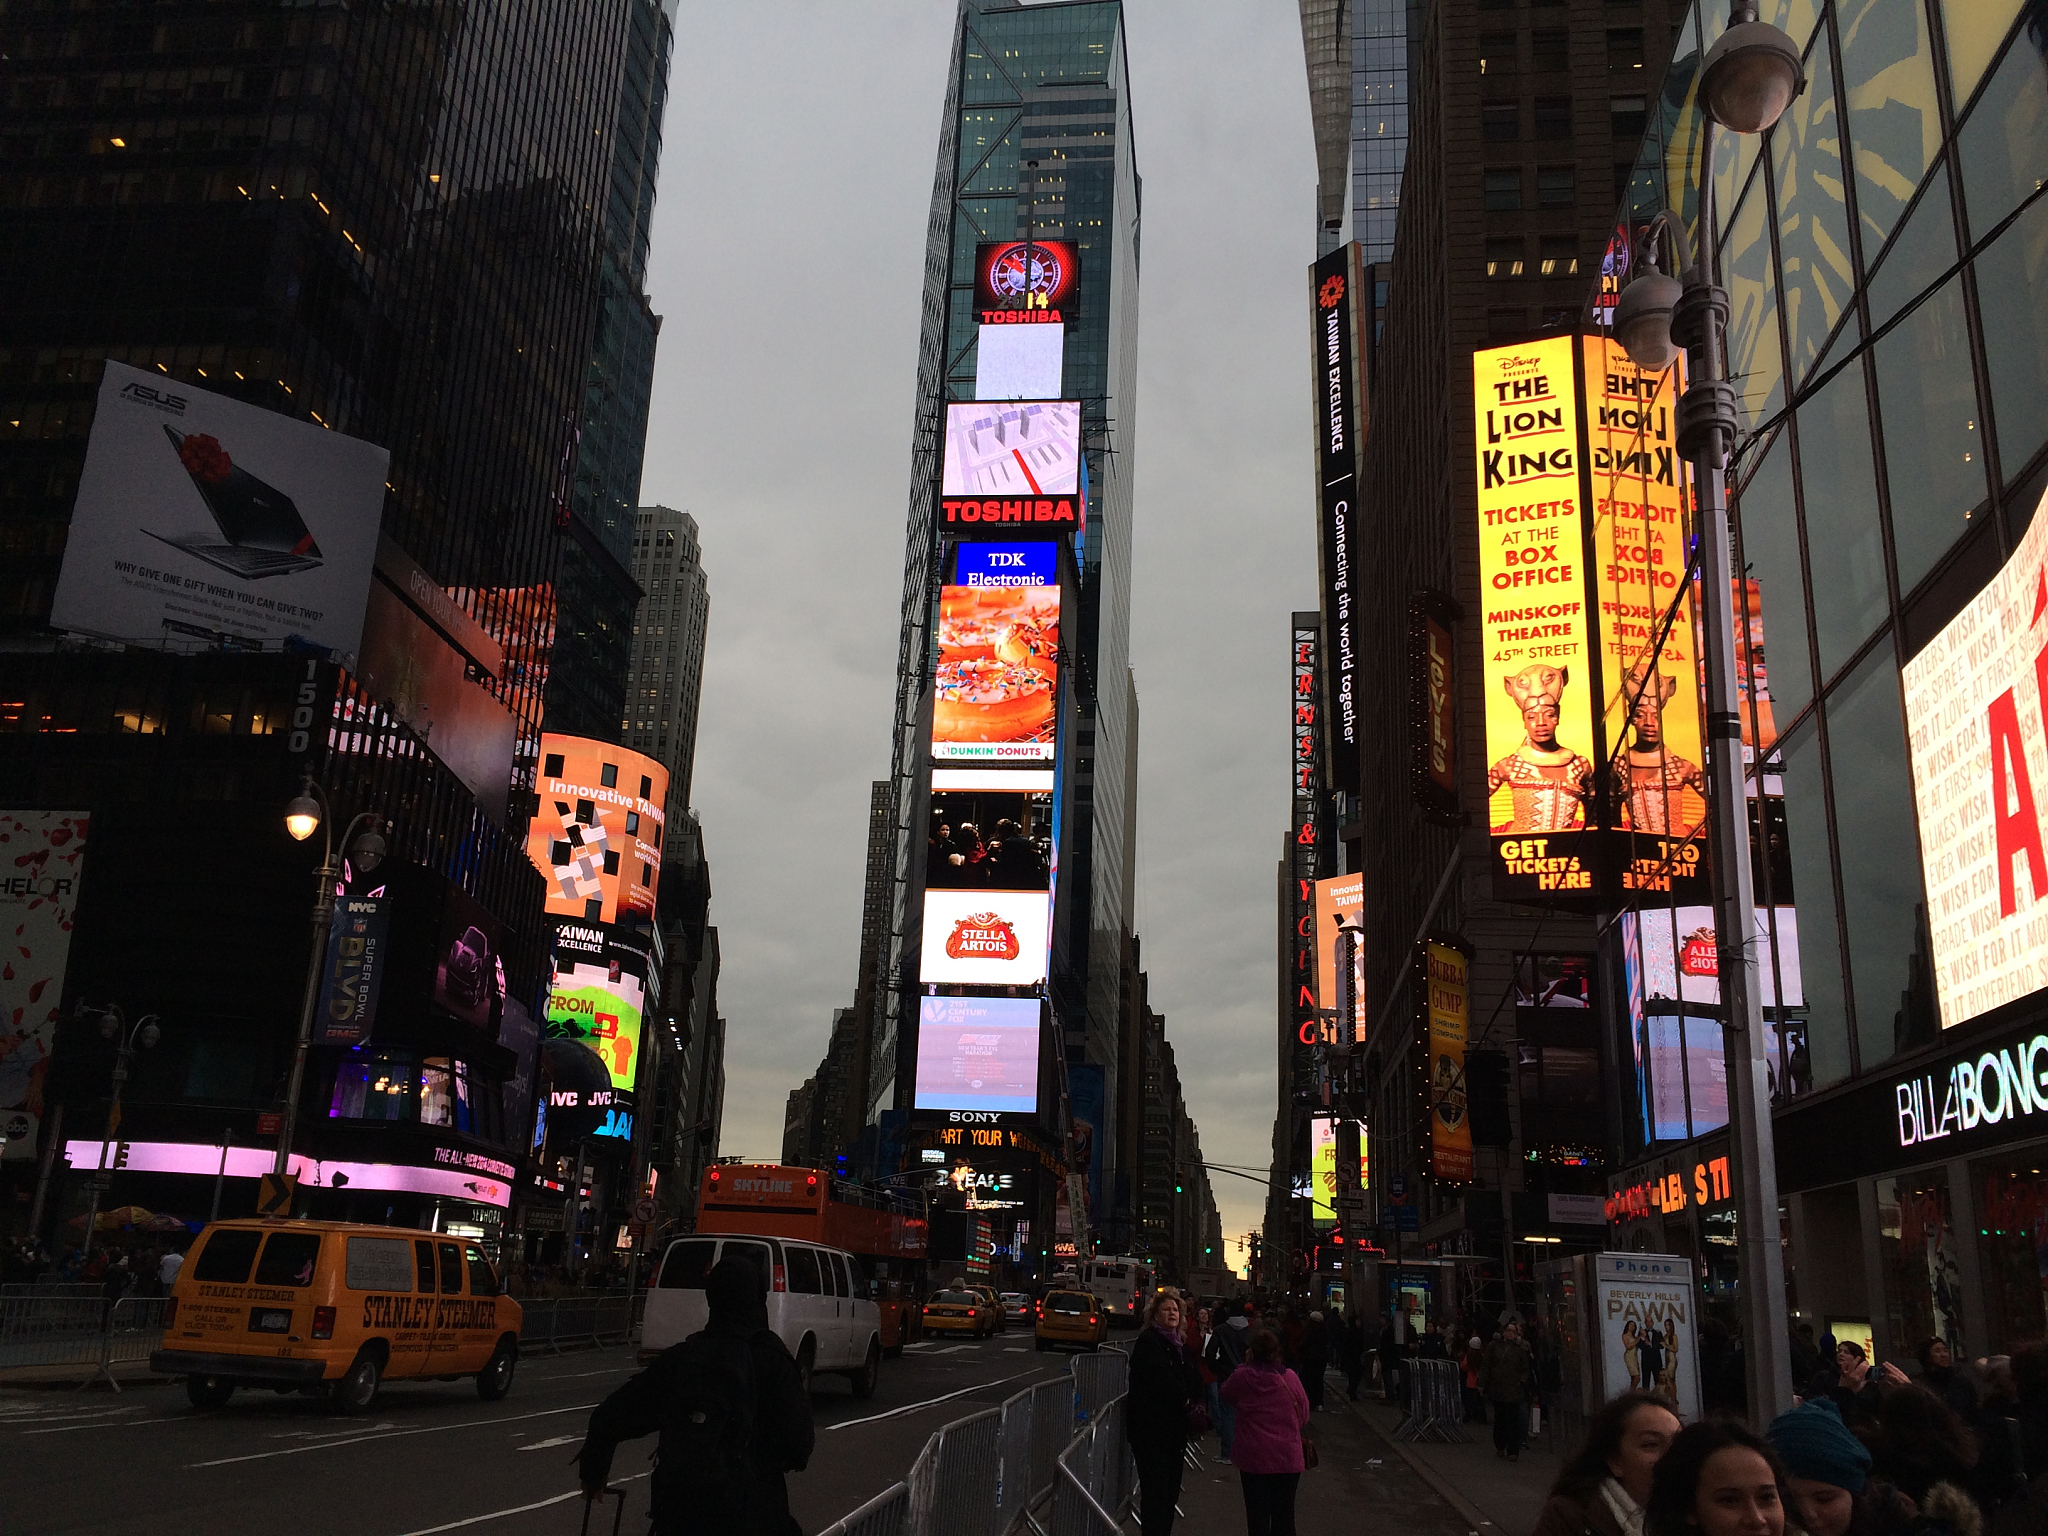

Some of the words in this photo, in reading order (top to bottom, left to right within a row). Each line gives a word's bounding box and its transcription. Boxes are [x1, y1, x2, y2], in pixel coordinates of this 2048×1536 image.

[996, 291, 1049, 310] 2014
[981, 310, 1062, 324] TOSHIBA
[1327, 308, 1339, 366] TAIWAN
[1503, 367, 1539, 377] PRESENTS
[121, 382, 187, 410] ASUS
[1493, 374, 1549, 402] THE
[1329, 366, 1343, 454] EXCELLENCE
[1486, 407, 1562, 444] LION
[1483, 447, 1573, 490] KING
[942, 501, 1074, 522] TOSHIBA
[1484, 499, 1575, 526] TICKETS
[1335, 500, 1348, 591] Connecting
[1501, 530, 1521, 546] AT
[1526, 526, 1559, 542] THE
[988, 553, 1026, 567] TDK
[1505, 545, 1558, 567] BOX
[967, 572, 1045, 586] Electronic
[1492, 565, 1572, 590] OFFICE
[115, 560, 137, 574] WHY
[138, 566, 161, 580] GIVE
[163, 572, 182, 586] ONE
[184, 578, 206, 592] GIFT
[207, 583, 234, 599] WHEN
[237, 591, 255, 605] YOU
[256, 596, 275, 610] CAN
[277, 602, 297, 616] GIVE
[300, 607, 323, 621] TWO?
[1339, 592, 1351, 620] the
[1487, 602, 1581, 624] MINSKOFF
[1946, 606, 1977, 654] WISH
[1978, 582, 2001, 623] FOR
[2002, 565, 2012, 598] IT
[1498, 623, 1572, 642] THEATRE
[1340, 623, 1354, 671] world
[1493, 647, 1523, 661] 45TH
[1529, 643, 1579, 659] STREET
[1931, 654, 1966, 705] SPREE
[1967, 624, 1998, 673] WISH
[2001, 600, 2020, 643] FOR
[2022, 584, 2032, 614] IT
[1931, 712, 1941, 740] IT
[1943, 687, 1971, 730] LOVE
[1972, 672, 1985, 707] AT
[1986, 643, 2019, 694] FIRST
[288, 659, 317, 753] 1500
[1297, 644, 1315, 788] ERNST
[1339, 674, 1356, 744] together
[950, 746, 996, 756] DUNKIN'
[996, 747, 1041, 756] DONUTS
[1927, 739, 1956, 779] WISH
[1956, 719, 1979, 758] FOR
[550, 779, 633, 808] Innovative
[1931, 783, 1942, 814] AT
[1944, 759, 1973, 804] FIRST
[1928, 811, 1957, 853] LIKES
[1959, 789, 1989, 830] WISH
[1297, 823, 1316, 844] &
[1500, 839, 1549, 860] GET
[1929, 851, 1955, 888] EVER
[1956, 830, 1986, 870] WISH
[1506, 856, 1581, 875] TICKETS
[1539, 871, 1592, 890] HERE
[1940, 879, 1970, 917] WISH
[1972, 863, 1996, 899] FOR
[348, 901, 377, 913] NYC
[961, 928, 1007, 941] STELLA
[1934, 917, 1969, 958] GRADE
[1969, 900, 2000, 939] WISH
[959, 940, 1007, 953] ARTOIS
[1950, 949, 1980, 986] WISH
[1983, 937, 2008, 971] FOR
[2010, 928, 2023, 958] IT
[362, 938, 376, 981] SUPER
[1429, 952, 1465, 988] BUBBA
[329, 936, 365, 1021] BLVD
[355, 985, 369, 1021] BOWL
[1431, 984, 1463, 1015] GUMP
[1954, 994, 1965, 1022] IT
[1968, 963, 2034, 1017] BOYFRIEND
[549, 995, 594, 1014] FROM
[948, 1008, 987, 1017] CENTURY
[1432, 1027, 1465, 1042] COMPANY
[1434, 1017, 1460, 1031] SHRIMP
[588, 1091, 611, 1106] JVC
[1896, 1034, 2048, 1148] BILLABONG
[949, 1112, 1001, 1123] SONY
[970, 1129, 1002, 1147] YOUR
[434, 1147, 451, 1162] THE
[1434, 1150, 1472, 1165] RESTAURANT
[1440, 1163, 1466, 1176] MARKET
[733, 1179, 793, 1193] SKYLINE
[1615, 1260, 1672, 1273] Phone
[198, 1284, 246, 1298] STANLEY
[247, 1287, 295, 1301] STEEMER
[1609, 1289, 1652, 1300] BEVERLY
[1654, 1292, 1681, 1302] HILLS
[195, 1314, 213, 1323] CALL
[216, 1315, 227, 1323] OR
[204, 1305, 240, 1314] STEEMER
[363, 1295, 435, 1328] STANLEY
[437, 1298, 496, 1330] STEEMER
[1607, 1299, 1686, 1325] PAWN
[184, 1321, 207, 1330] CLICK
